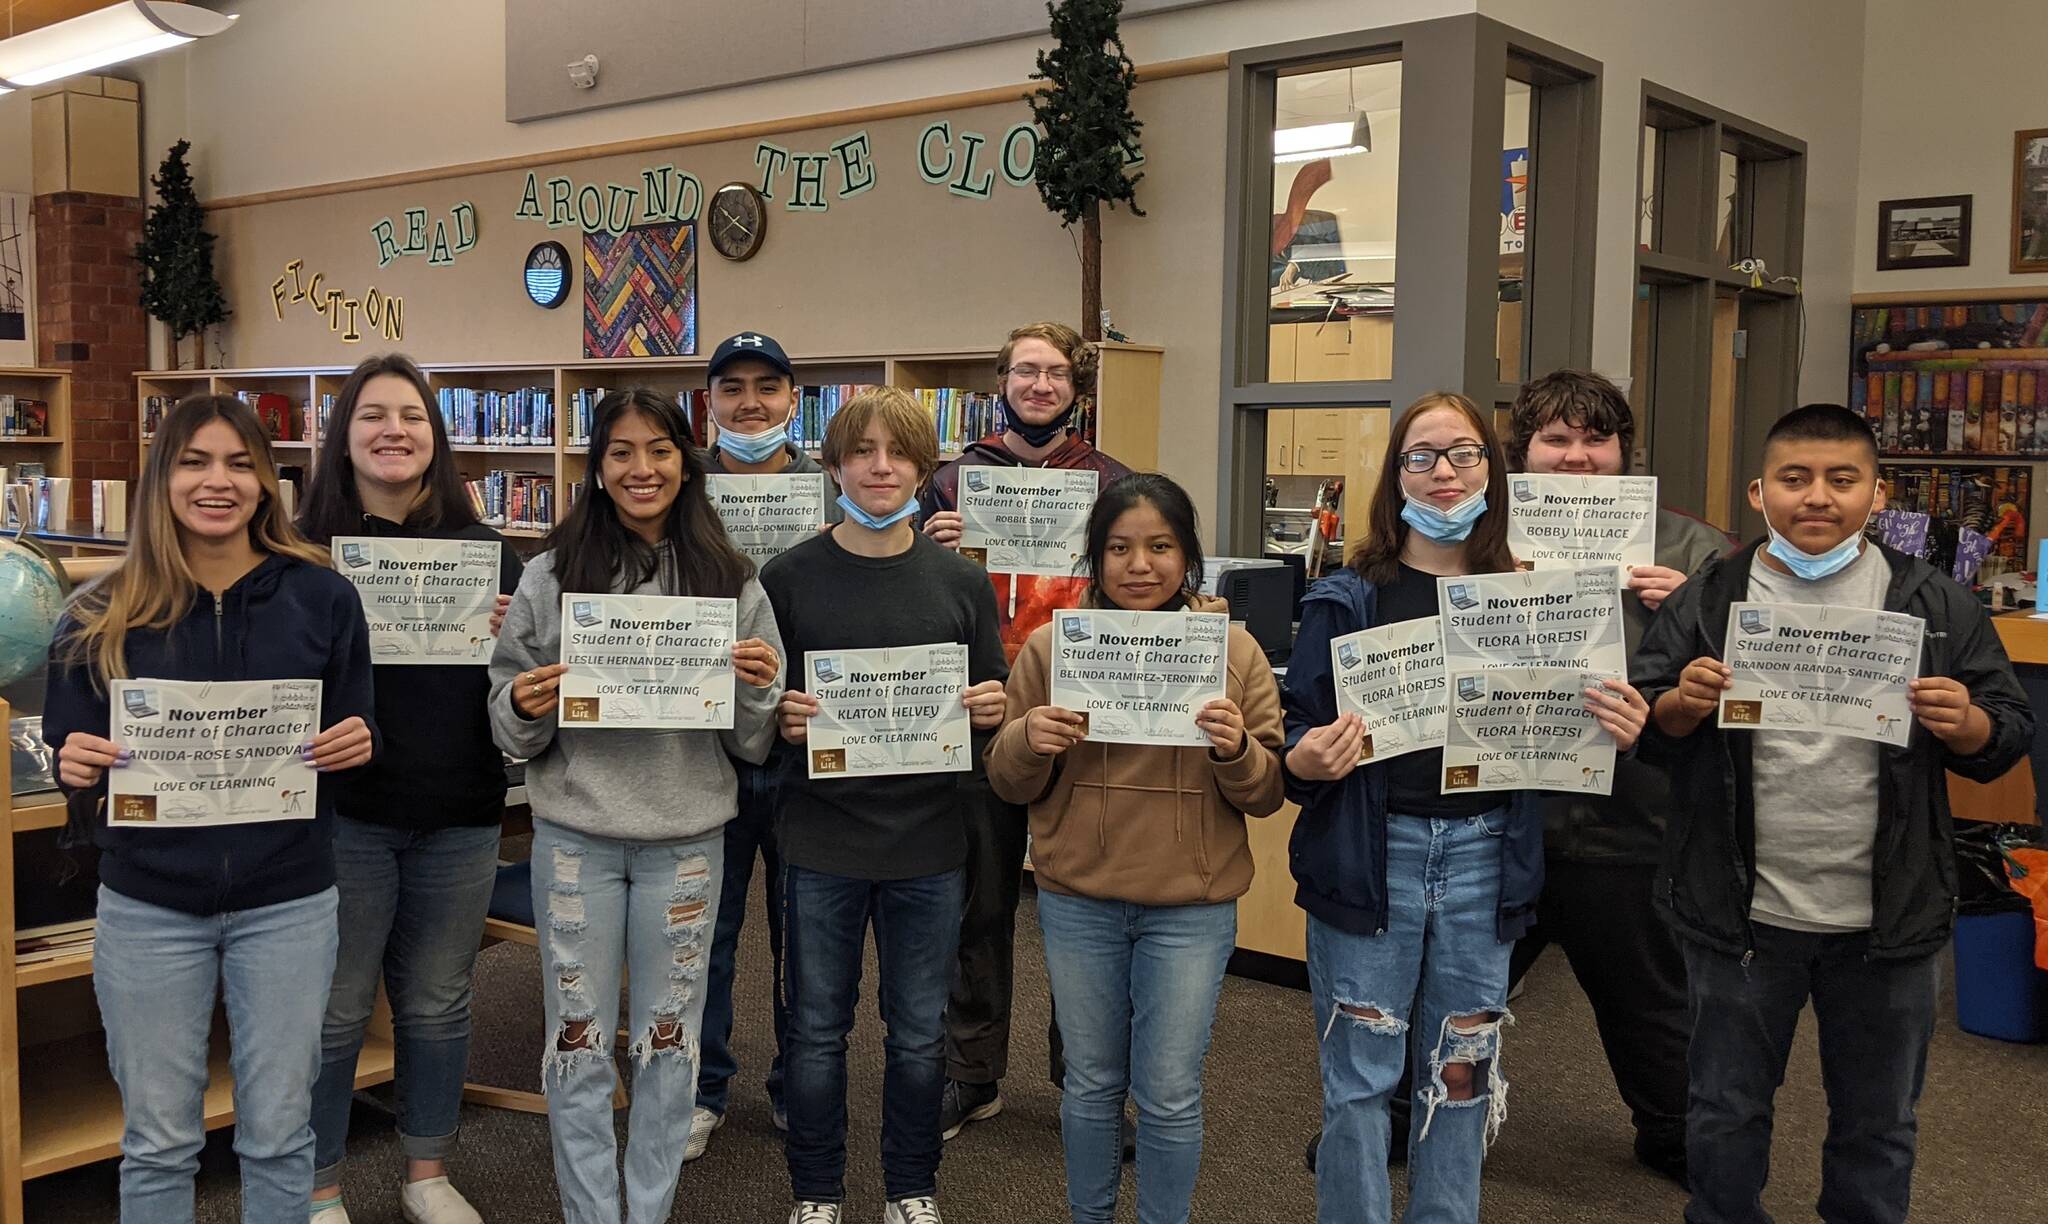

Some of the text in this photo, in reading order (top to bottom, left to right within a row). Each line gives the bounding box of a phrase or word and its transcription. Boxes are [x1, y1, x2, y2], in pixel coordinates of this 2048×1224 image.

[370, 203, 478, 267] READ
[514, 165, 704, 236] AROUND
[755, 133, 875, 210] THE
[271, 258, 404, 343] FICTION
[996, 485, 1062, 496] November
[721, 494, 788, 504] November
[966, 496, 1091, 510] Student of Character
[1544, 494, 1616, 505] November
[743, 507, 756, 517] of
[759, 506, 818, 516] Character
[1512, 507, 1648, 520] Student of Character
[995, 515, 1056, 525] ROBBIE SMITH
[727, 524, 817, 533] GARCIA-DOMINGUEZ
[1527, 526, 1629, 538] BOBBY WALLACE
[985, 538, 1005, 546] LOVE
[1022, 539, 1066, 549] LEARNING
[752, 547, 791, 555] LEARNI
[1533, 550, 1622, 561] LOVE OF LEARNING
[379, 560, 458, 571] November
[346, 574, 493, 587] tudent of Character
[378, 595, 411, 604] HOLLY
[1487, 593, 1573, 610] November
[1451, 606, 1614, 627] Student of Character
[396, 623, 410, 631] OF
[412, 623, 466, 633] LEARNING
[610, 618, 692, 631] November
[571, 633, 728, 647] Student of Character
[1099, 634, 1182, 647] November
[1477, 630, 1587, 648] FLORA HOREJSI
[1778, 626, 1871, 644] November
[1062, 648, 1219, 664] Student of Character
[1367, 642, 1435, 665] November
[1736, 640, 1911, 666] Student of Character
[568, 655, 728, 667] LESLIE HERNANDEZ-BELTRAN
[850, 670, 927, 683] November
[1060, 670, 1217, 684] BELINDA RAMIREZ-JERONIMO
[1342, 656, 1444, 688] Student of Chara
[1733, 660, 1906, 685] BRANDON ARANDA-SANTIAGO
[597, 685, 700, 696] LOVE OF LEARNING
[816, 684, 962, 700] Student of Character
[1362, 677, 1445, 705] FLORA HOREJS
[1492, 690, 1574, 701] November
[1760, 689, 1872, 708] LOVE OF LEARNING
[838, 705, 939, 720] KLATON HELVEY
[1087, 700, 1189, 713] LOVE OF LEARNING
[1456, 704, 1595, 718] Student of Charac
[169, 707, 267, 721] November
[1368, 718, 1387, 730] LOVE
[1389, 713, 1400, 724] OF
[1402, 705, 1448, 721] LEARNIN
[123, 721, 311, 740] Student of Character
[1477, 725, 1582, 738] FLORA HOREJSI
[842, 732, 938, 745] LOVE OF LEARNING
[128, 749, 231, 761] ANDIDA-ROSE
[1477, 752, 1578, 762] LOVE OF LEARNING
[154, 781, 185, 791] LOVE
[189, 781, 206, 791] OF
[210, 776, 276, 791] LEARNING
